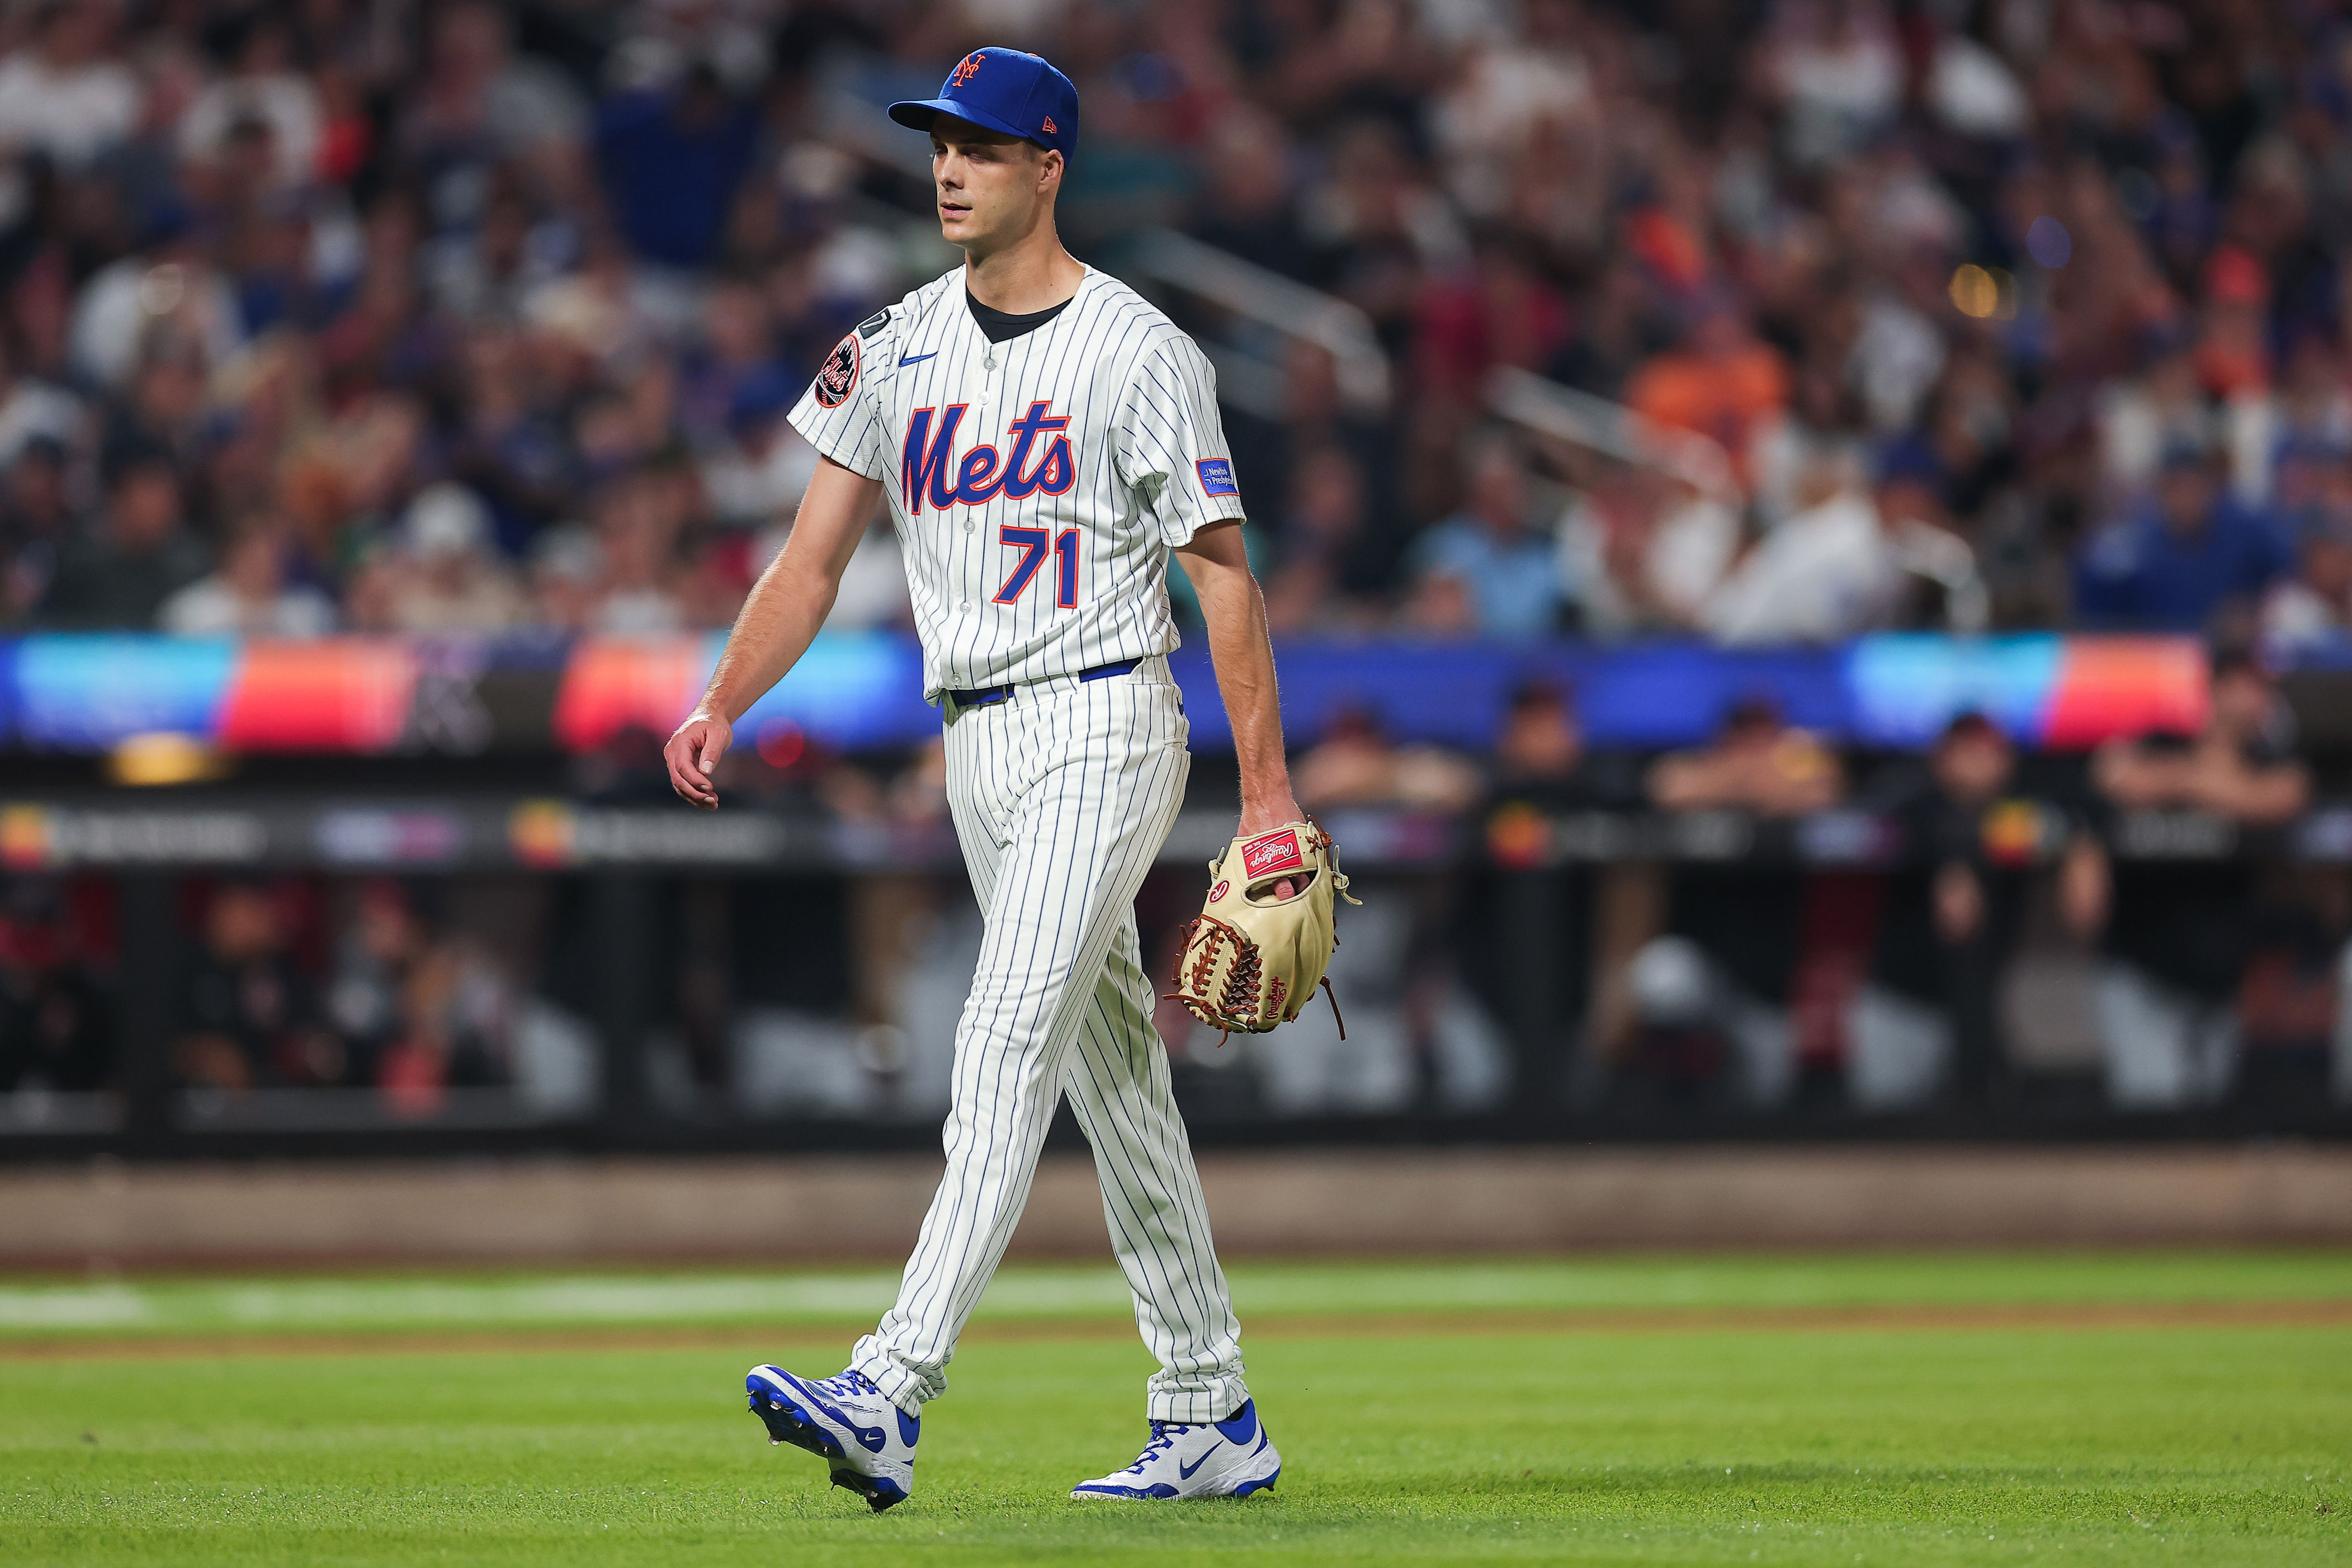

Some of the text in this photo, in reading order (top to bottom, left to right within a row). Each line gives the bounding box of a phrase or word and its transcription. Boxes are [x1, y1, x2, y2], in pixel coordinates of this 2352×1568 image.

[952, 54, 986, 87] NY
[824, 357, 848, 391] Mets
[902, 400, 1075, 516] Mets
[992, 525, 1080, 608] 71
[1249, 842, 1293, 868] Rawlings
[1211, 881, 1228, 901] R
[1265, 976, 1285, 1020] Rawlings
